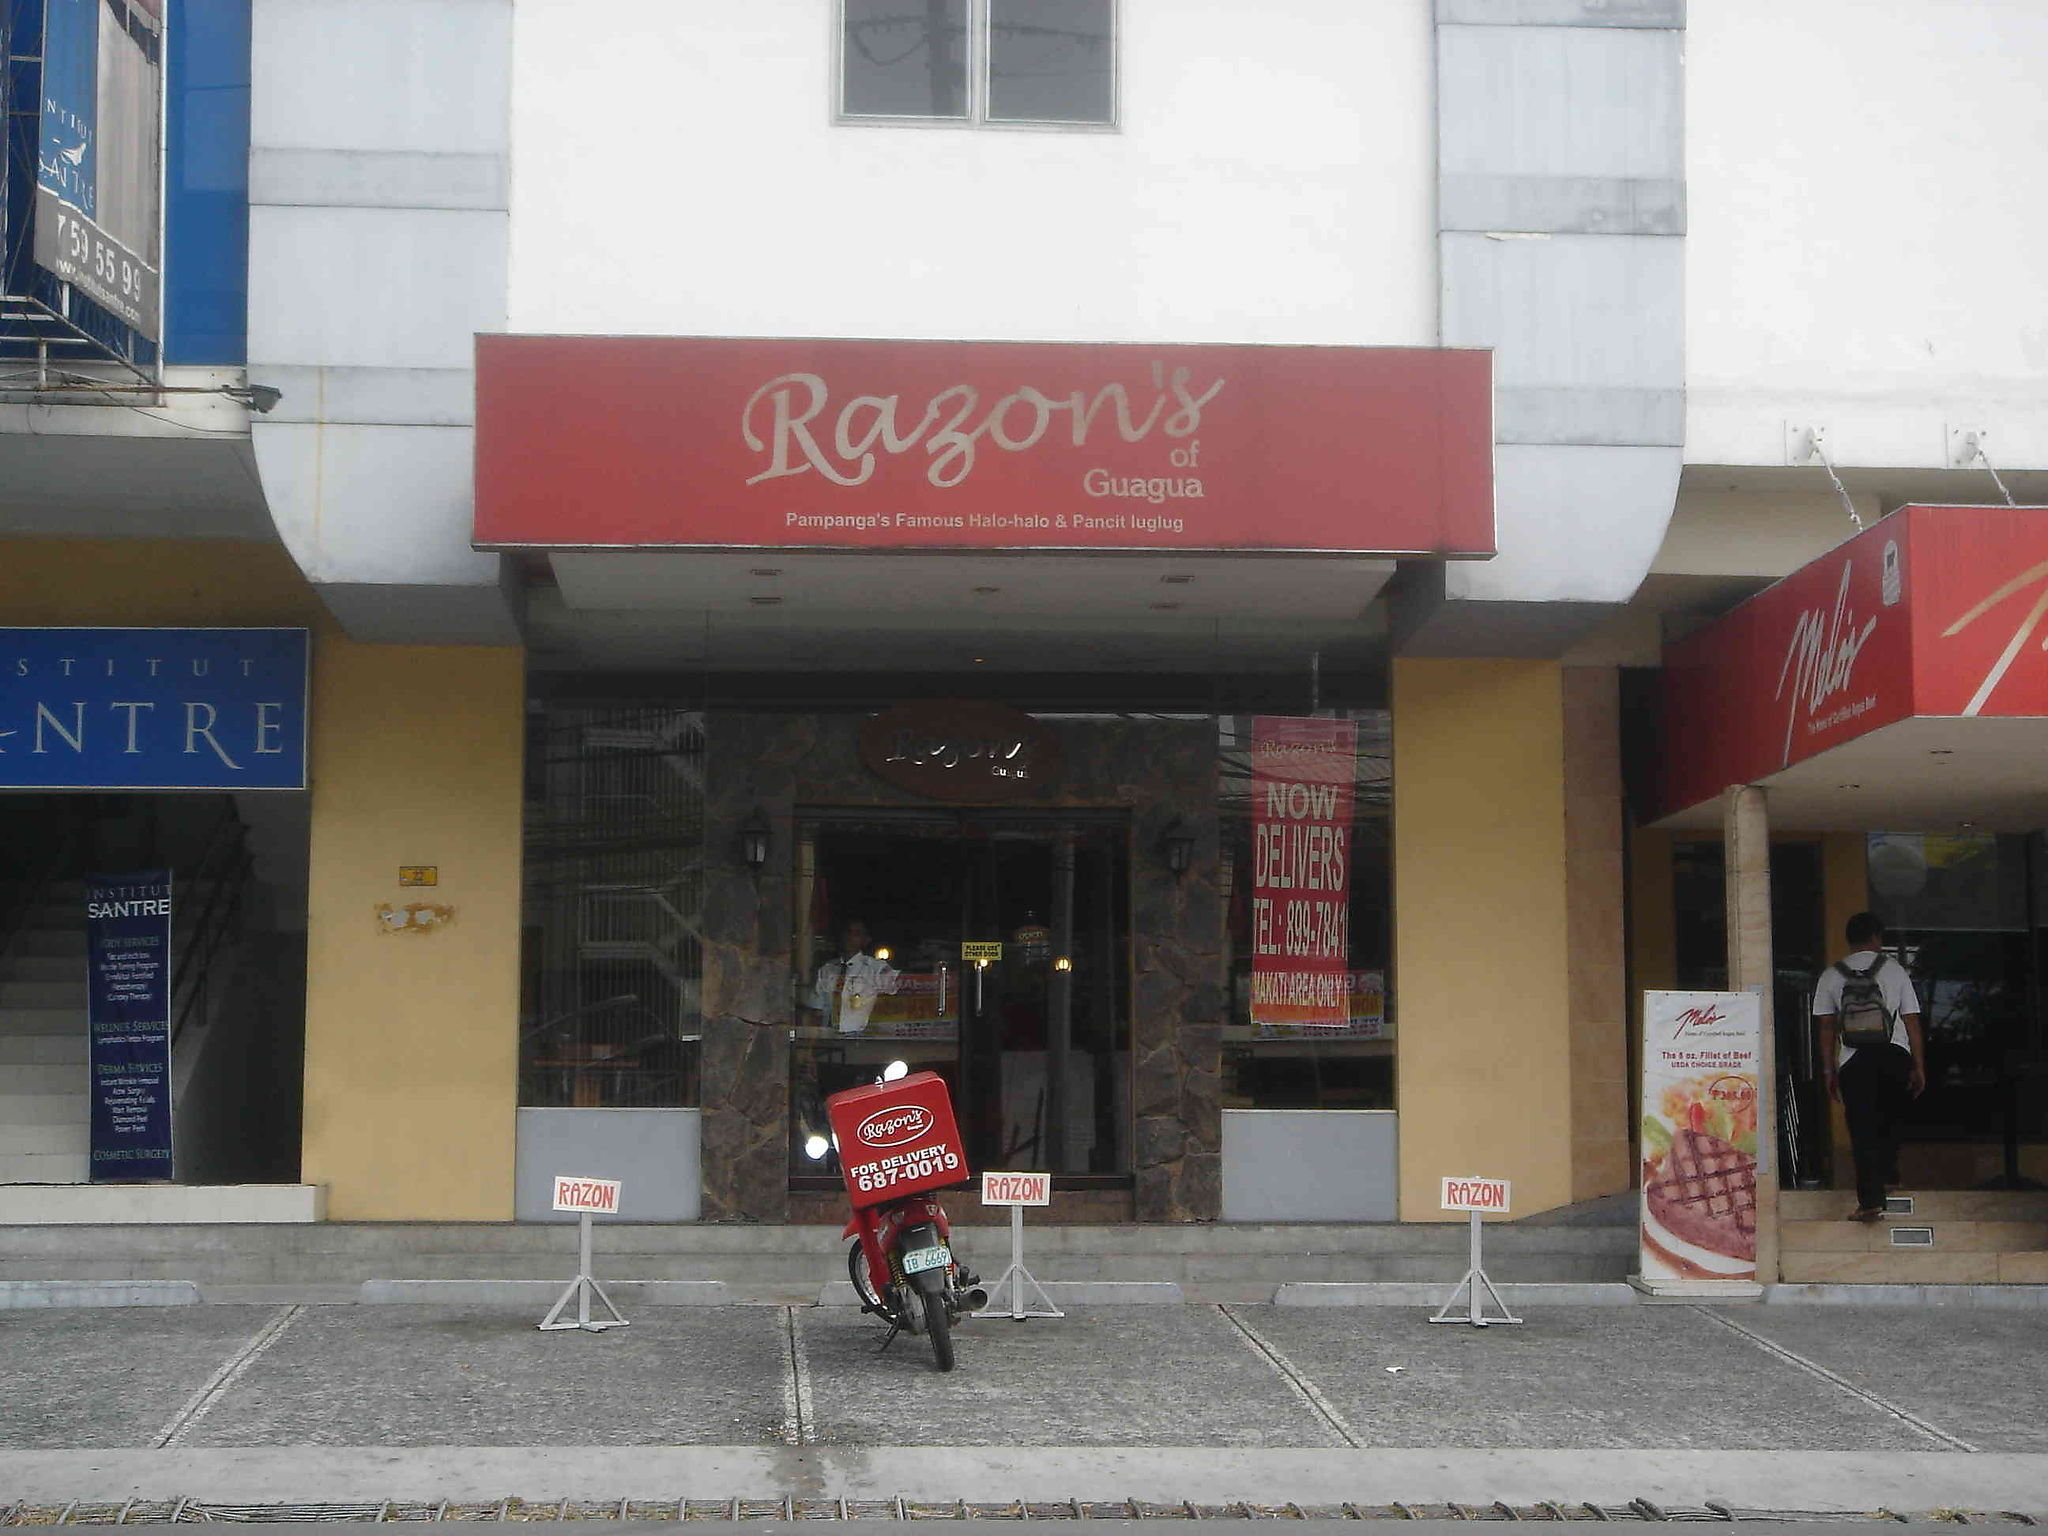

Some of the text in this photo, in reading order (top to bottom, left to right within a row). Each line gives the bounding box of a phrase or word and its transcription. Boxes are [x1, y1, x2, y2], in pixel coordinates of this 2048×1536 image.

[741, 360, 1225, 488] Razon's
[1170, 439, 1200, 467] of
[1083, 468, 1204, 503] Guagua
[786, 512, 890, 530] Pampanga's
[896, 513, 963, 528] Famous
[969, 513, 1050, 529] Halo-halo
[1055, 514, 1067, 528] &
[1073, 514, 1126, 529] Pancit
[0, 701, 282, 770] NTRE
[1267, 782, 1338, 820] NOW
[1256, 823, 1345, 891] DELIVERS
[88, 899, 171, 919] SANTRE
[1253, 898, 1346, 958] TEL: 899-7841
[1288, 972, 1315, 1006] AREA
[131, 1020, 169, 1032] SERVICES
[1662, 1051, 1676, 1060] The
[1700, 1051, 1721, 1060] Fillet
[1722, 1051, 1731, 1060] of
[1733, 1051, 1752, 1060] Beef
[1691, 1061, 1717, 1069] CHOICE
[863, 1110, 923, 1141] Razon's
[850, 1143, 947, 1179] FOR DELIVERY
[858, 1152, 959, 1192] 687-0019
[558, 1182, 615, 1209] RAZON
[987, 1177, 1044, 1201] RAZON
[1448, 1181, 1505, 1208] RAZON
